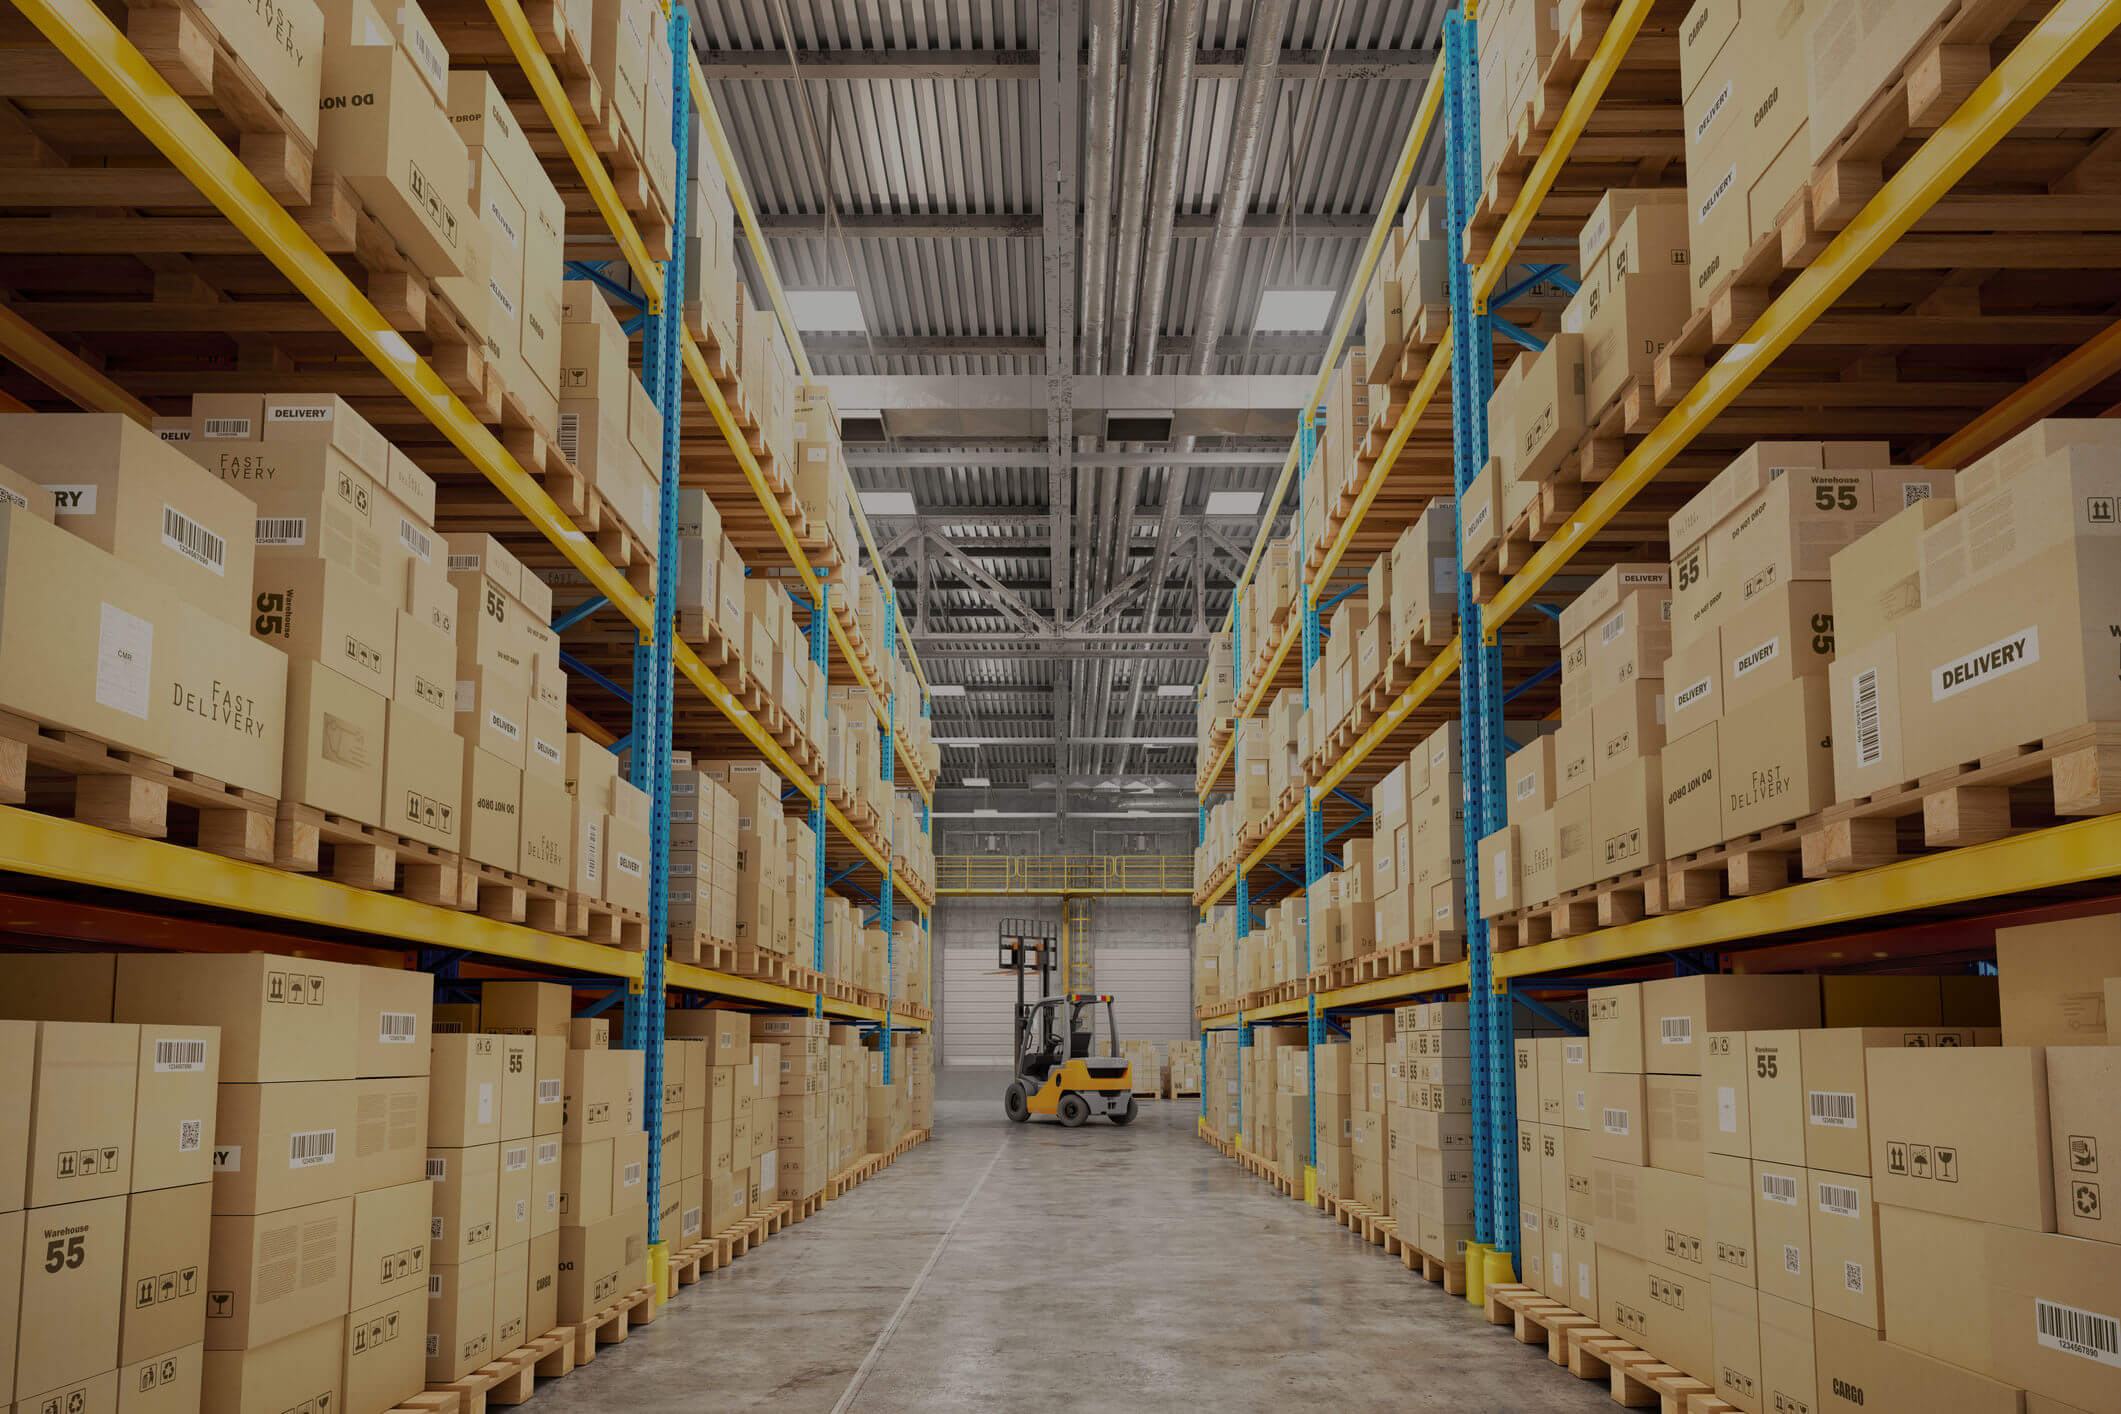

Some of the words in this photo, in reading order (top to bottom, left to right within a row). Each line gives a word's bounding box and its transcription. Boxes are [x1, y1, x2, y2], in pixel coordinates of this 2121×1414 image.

[1688, 8, 1709, 47] CARGO
[1698, 86, 1729, 135] DELIVERY
[1754, 86, 1779, 128] CARGO
[456, 114, 481, 123] DROP
[1702, 171, 1734, 217] DELIVERY
[1699, 255, 1720, 288] CARGO
[275, 409, 327, 419] DELIVERY
[160, 432, 190, 441] DELIV
[220, 453, 265, 468] FAST
[218, 467, 276, 480] IVERY
[1811, 476, 1860, 484] Warehouse
[1815, 486, 1857, 511] 55
[1467, 507, 1488, 537] DELIVERY
[1624, 575, 1663, 583] DELIVERY
[1679, 555, 1699, 591] 55
[256, 591, 284, 635] 55
[284, 588, 295, 640] Warehouse
[486, 590, 504, 623] 55
[1738, 642, 1775, 672] DELIVERY
[1942, 637, 2026, 690] DELIVERY
[211, 680, 254, 717] FAST
[1678, 680, 1708, 706] DELIVERY
[172, 682, 265, 739] DELIVERY
[493, 715, 517, 736] DELIVERY
[537, 741, 559, 760] DELIVERY
[1687, 774, 1701, 793] NOT
[1702, 768, 1712, 782] DO
[1752, 765, 1781, 789] FAST
[477, 797, 494, 811] DROP
[1668, 784, 1687, 805] DROP
[1729, 776, 1791, 812] DELIVERY
[620, 856, 640, 872] DELIVERY
[509, 1054, 522, 1073] 55
[1519, 1054, 1528, 1069] 55
[1757, 1055, 1778, 1078] 55
[1522, 1136, 1531, 1153] 55
[1544, 1140, 1555, 1157] 55
[44, 1223, 89, 1239] Warehouse
[45, 1236, 85, 1274] 55
[536, 1274, 551, 1292] CARGO
[2058, 1340, 2099, 1358] 1234567890
[1832, 1377, 1864, 1407] CARGO
